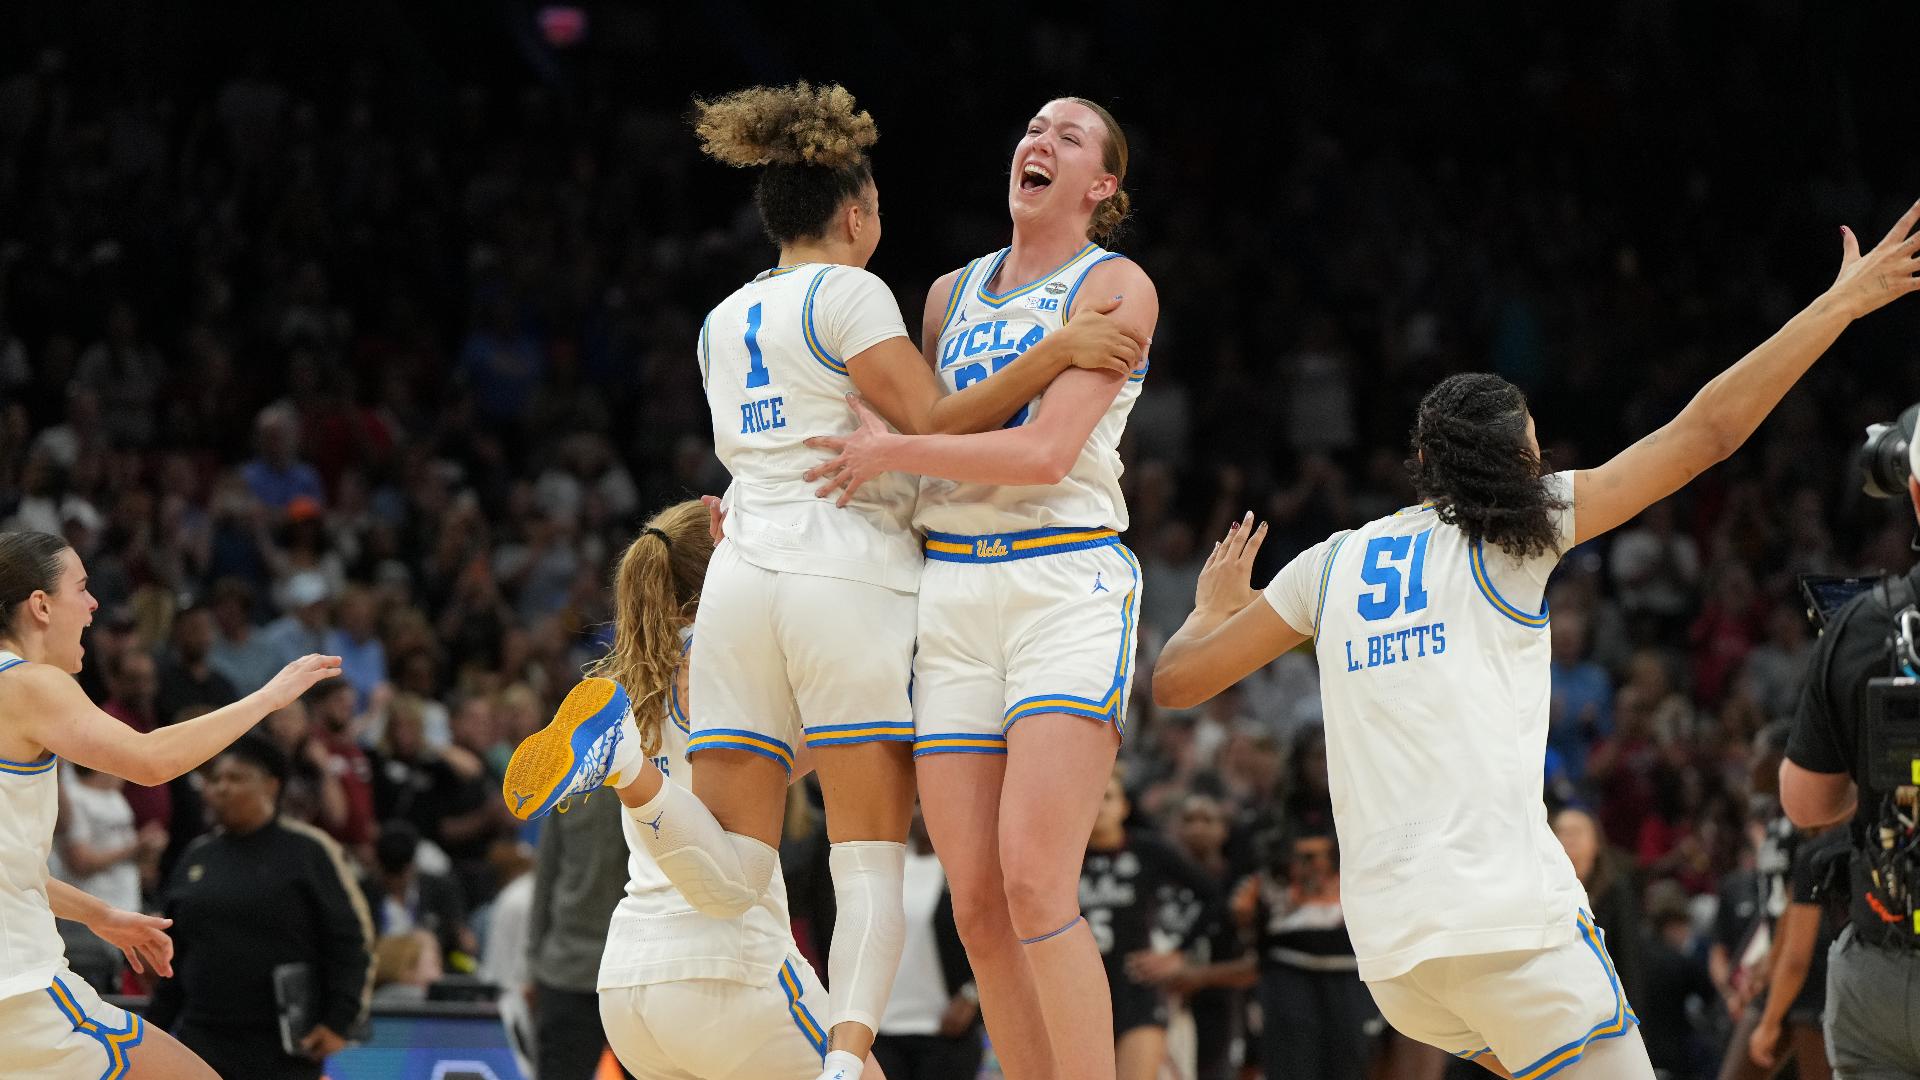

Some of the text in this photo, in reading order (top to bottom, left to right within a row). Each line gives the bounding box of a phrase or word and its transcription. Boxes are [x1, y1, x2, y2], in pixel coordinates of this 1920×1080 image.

[744, 302, 770, 388] 1
[941, 320, 1044, 369] UCLA
[741, 397, 786, 434] RICE
[1357, 527, 1433, 622] 51
[1345, 622, 1447, 672] L. BETTS
